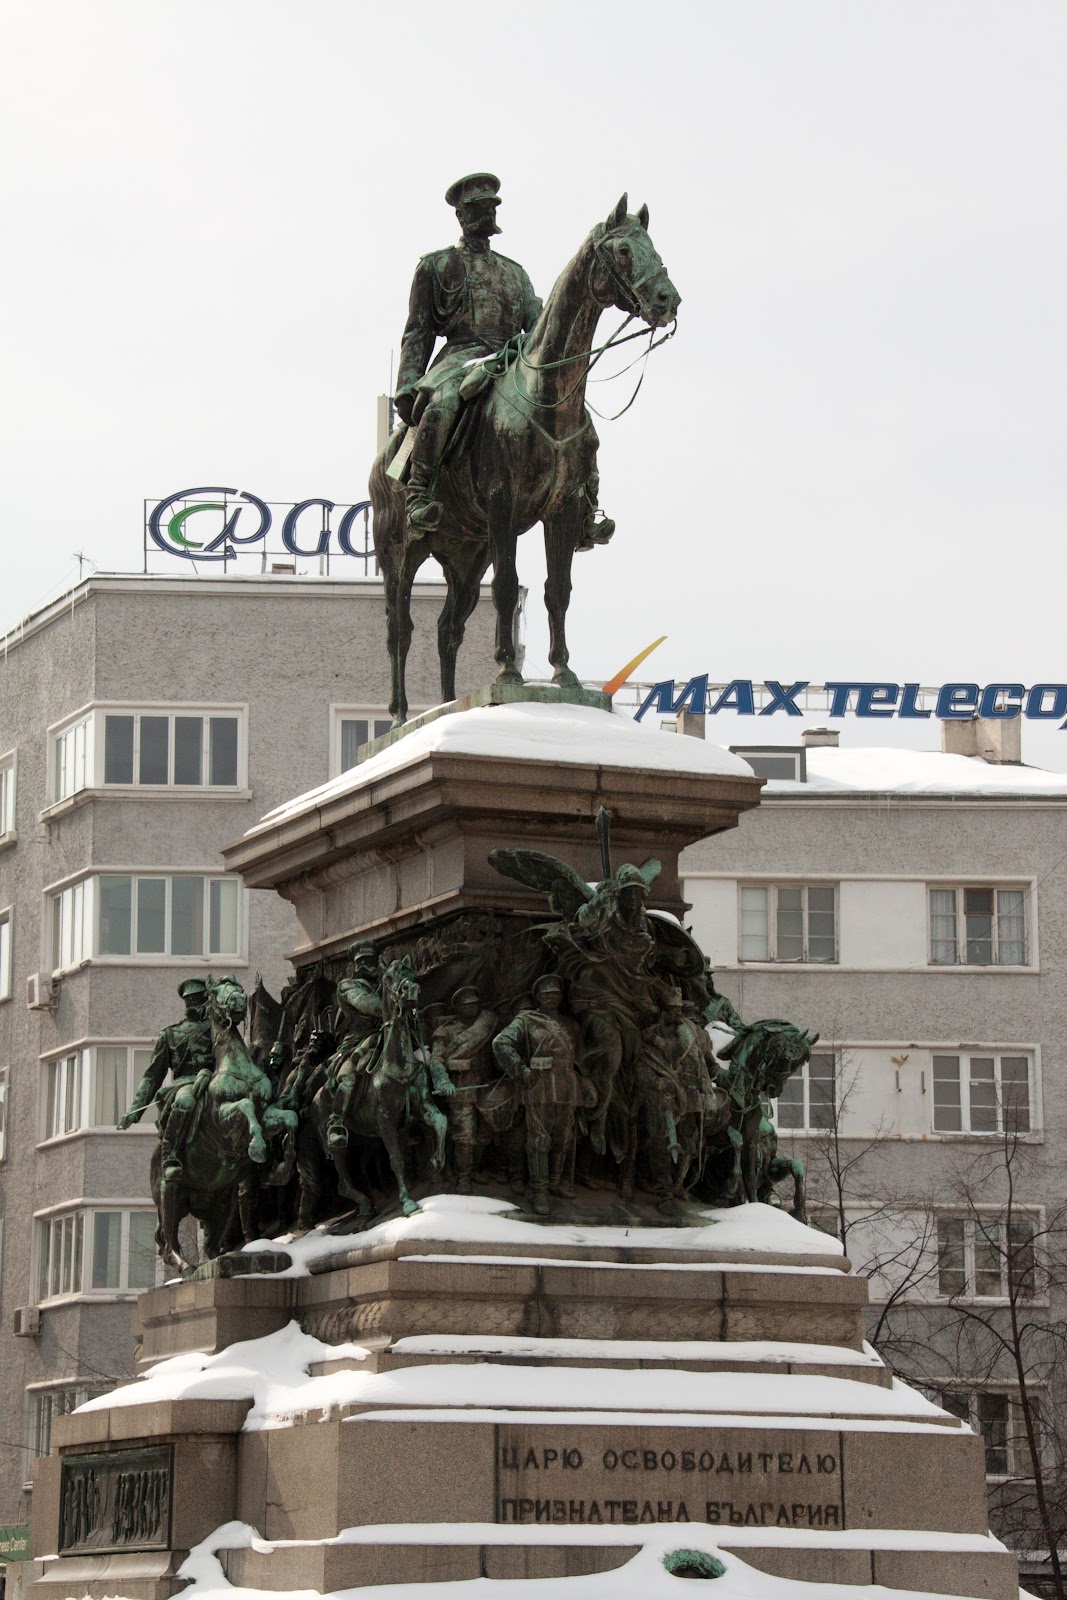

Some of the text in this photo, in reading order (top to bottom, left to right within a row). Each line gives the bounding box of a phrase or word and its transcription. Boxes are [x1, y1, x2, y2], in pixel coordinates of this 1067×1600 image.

[634, 673, 810, 722] MAX
[502, 1447, 838, 1475] ЦАРЮ ОСВОБОДИТЕЛЮ
[502, 1499, 840, 1526] ПРИЗНАТЕЛНА БЪЛГАРИЯ
